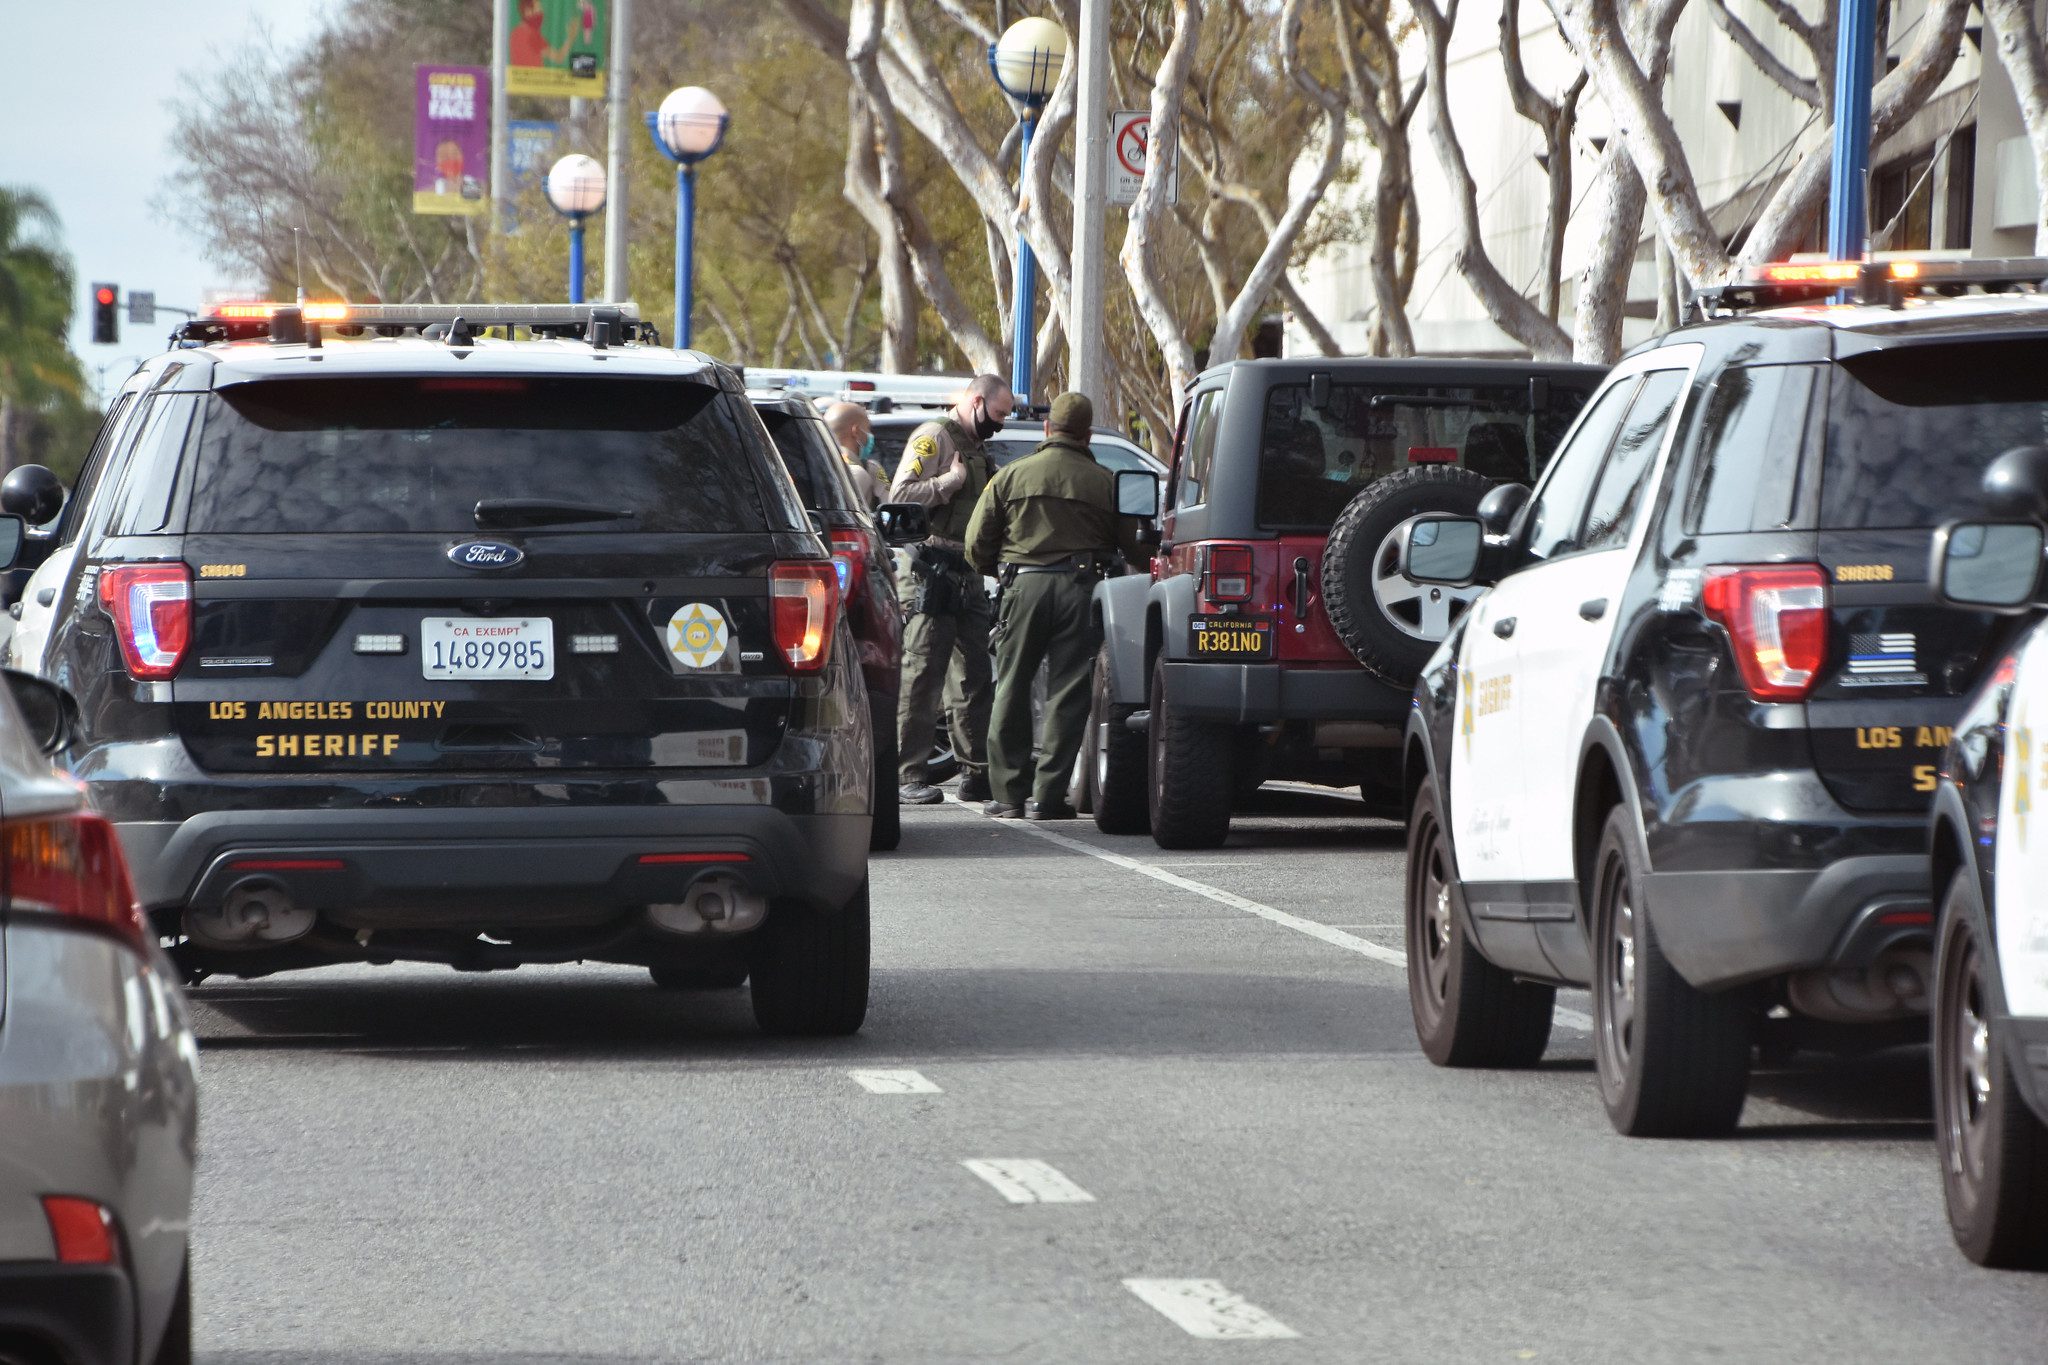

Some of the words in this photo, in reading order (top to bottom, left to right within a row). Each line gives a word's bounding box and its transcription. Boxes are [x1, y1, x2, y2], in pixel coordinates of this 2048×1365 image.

[465, 545, 506, 562] Ford
[454, 628, 469, 636] CA
[475, 628, 520, 636] EXEMPT
[1208, 621, 1252, 629] CALIFORNIA
[432, 640, 545, 670] 1489985
[209, 701, 247, 720] LOS
[257, 701, 352, 720] ANGELES
[366, 700, 446, 719] COUNTY
[255, 733, 400, 757] SHERIFF
[1857, 726, 1902, 749] LOS
